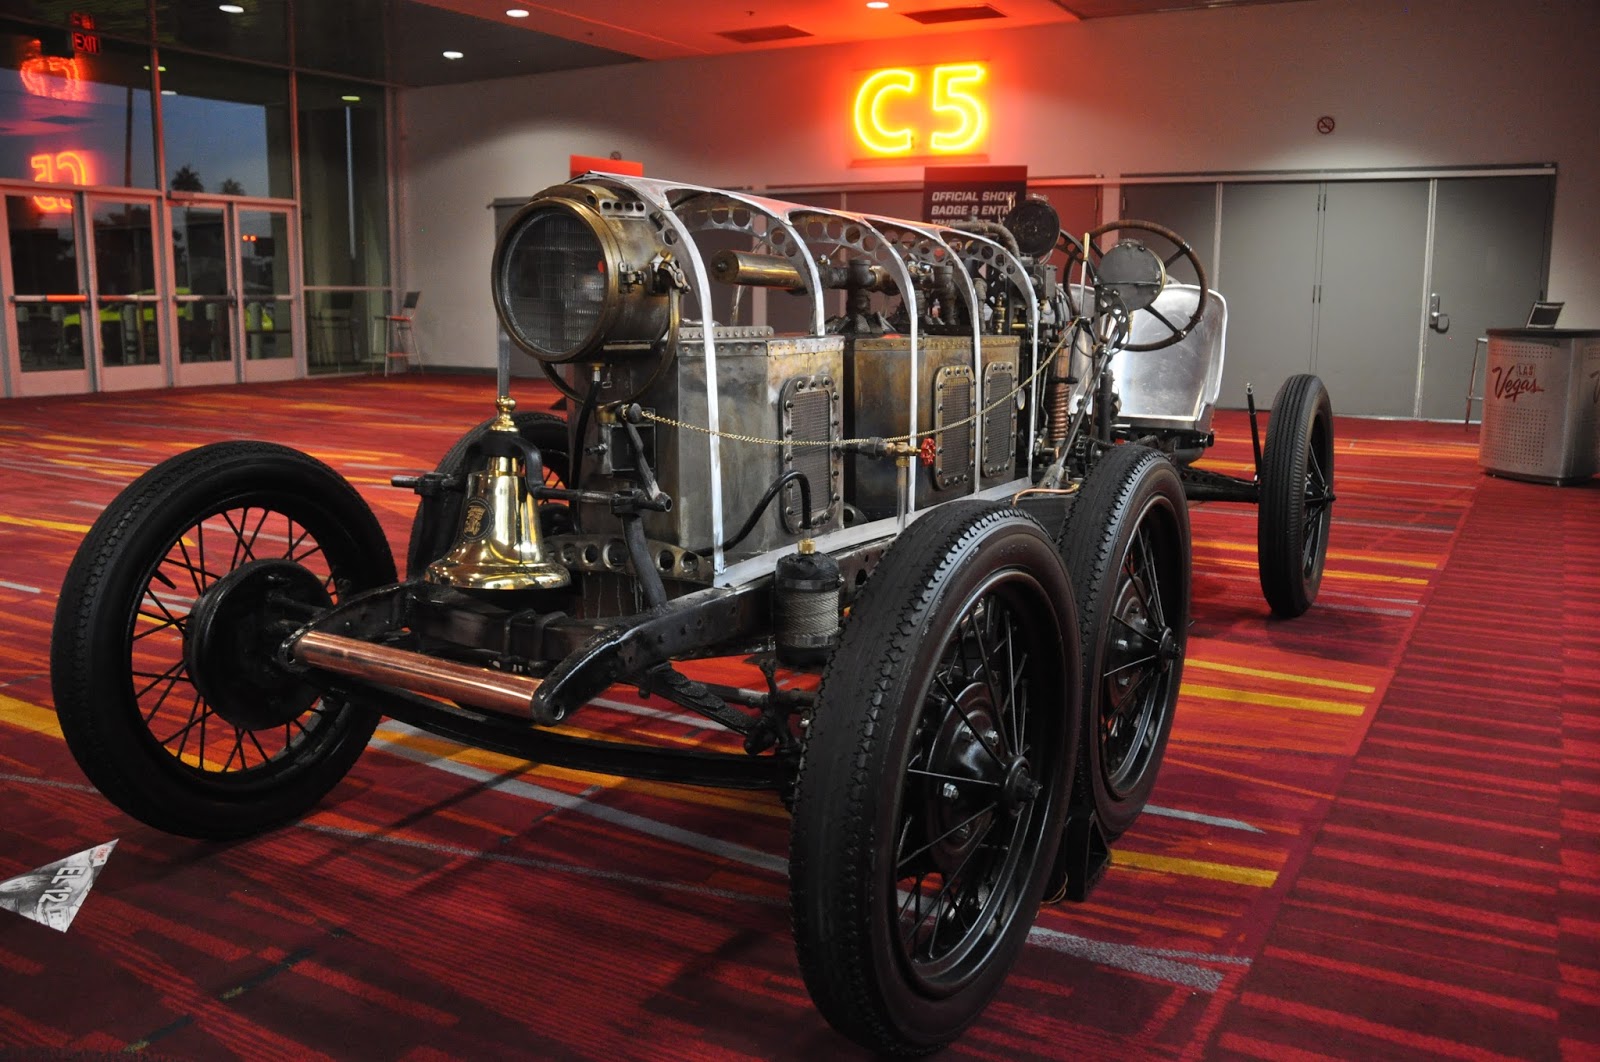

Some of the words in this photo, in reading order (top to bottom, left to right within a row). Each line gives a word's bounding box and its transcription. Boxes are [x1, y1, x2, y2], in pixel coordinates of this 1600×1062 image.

[73, 32, 98, 54] EXIT
[853, 65, 985, 154] C5
[932, 191, 978, 202] OFFICIAL
[982, 191, 1016, 202] SHOW
[931, 205, 968, 215] BADGE
[971, 206, 979, 215] &
[981, 205, 1009, 215] ENTR
[1518, 366, 1534, 376] LAS
[1492, 365, 1544, 402] Vegas
